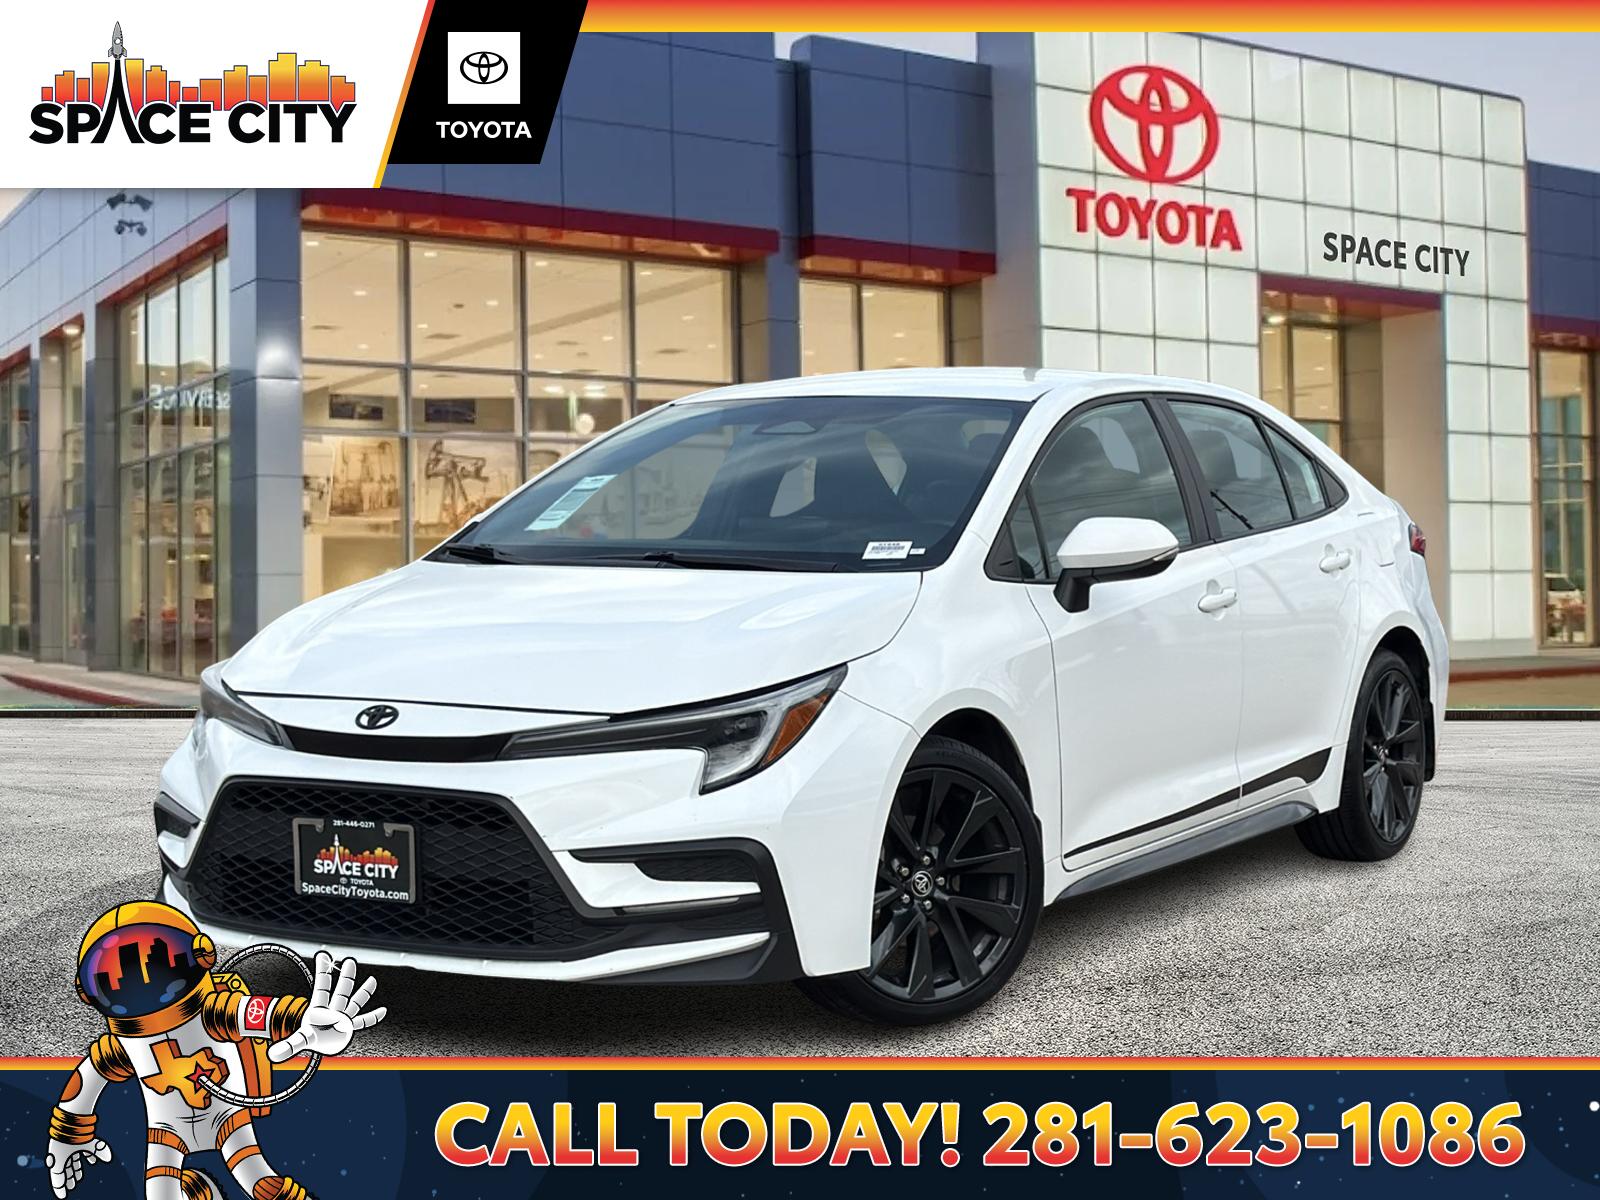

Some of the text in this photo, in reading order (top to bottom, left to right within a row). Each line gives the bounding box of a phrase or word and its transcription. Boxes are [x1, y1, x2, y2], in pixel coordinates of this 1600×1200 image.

[1066, 187, 1243, 251] TOYOTA
[1323, 232, 1470, 277] SPACE CITY
[364, 863, 399, 879] CITY
[302, 882, 409, 901] SpaceCityToyota.com
[350, 878, 374, 886] TOYOTA
